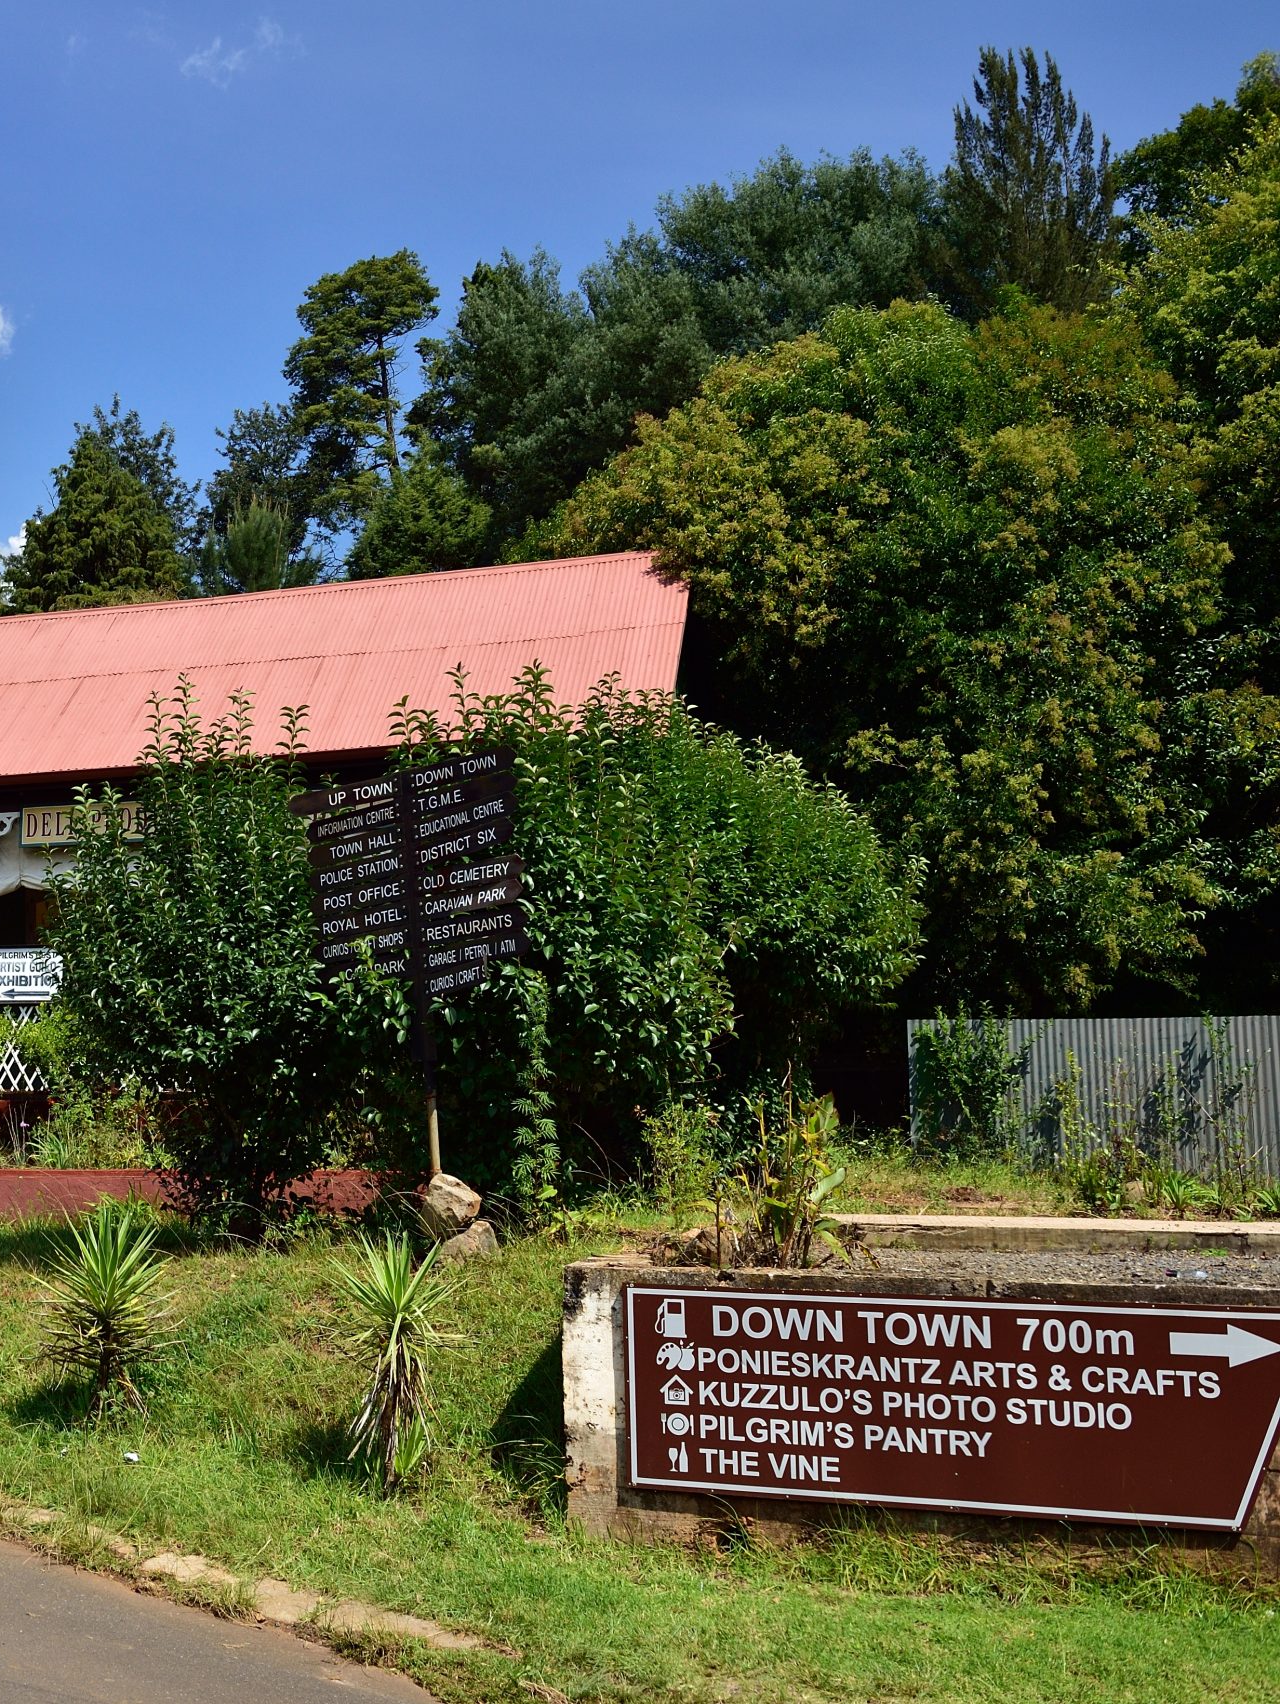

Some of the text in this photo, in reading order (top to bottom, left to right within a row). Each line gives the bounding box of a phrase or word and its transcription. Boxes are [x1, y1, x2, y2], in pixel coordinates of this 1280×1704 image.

[416, 754, 497, 786] DOWN TOWN
[328, 781, 393, 806] UP TOWN
[418, 789, 465, 811] T.G.M.E.
[317, 806, 395, 837] INFORMATION CENTRE
[420, 799, 505, 837] EDUCATIONAL CENTRE
[329, 832, 397, 859] TOWN HALL
[420, 827, 497, 863] DISTRICT SIX
[320, 857, 399, 887] POLICE STATION
[423, 862, 510, 890] OLD CEMETERY
[323, 882, 400, 911] POST OFFICE
[425, 886, 507, 915] CARAVAN PARK
[322, 908, 402, 935] ROYAL HOTEL
[426, 914, 513, 941] RESTAURANTS
[323, 942, 349, 959] CURIOS
[354, 937, 376, 953] CFT
[378, 932, 404, 948] SHOPS
[428, 949, 457, 967] GARAGE
[464, 944, 492, 960] PETROL
[500, 939, 516, 954] ATM
[30, 961, 57, 972] GUID
[430, 974, 454, 993] CURIOS
[458, 966, 480, 984] CRAFT
[712, 1304, 1135, 1355] DOWN TOWN 700m
[698, 1347, 1221, 1399] PONIESKRANTZ ARTS & CRAFTS
[699, 1380, 1132, 1430] KUZZULO’S PHOTO STUDIO
[699, 1414, 992, 1458] PILGRIM’S PANTRY
[699, 1448, 841, 1483] THE VINE
